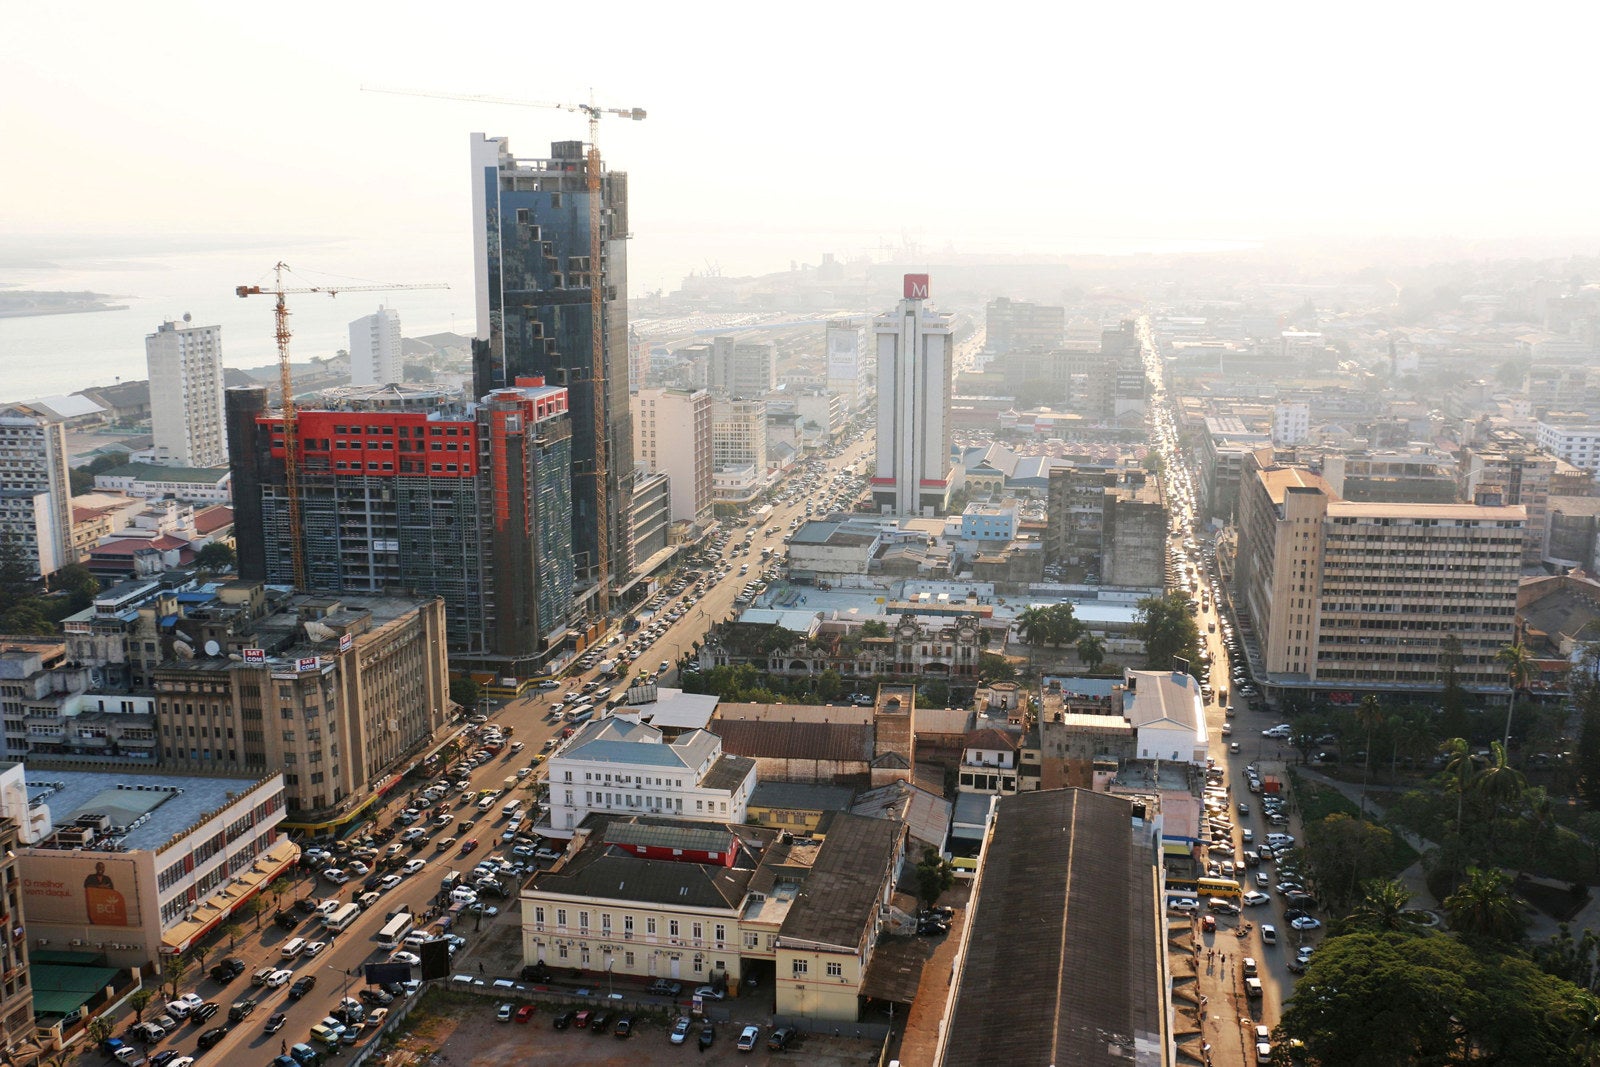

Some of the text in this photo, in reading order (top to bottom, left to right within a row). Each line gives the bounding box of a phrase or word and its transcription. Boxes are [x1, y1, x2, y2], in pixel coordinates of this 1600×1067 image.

[912, 282, 927, 297] M
[24, 879, 64, 888] O melhor
[97, 904, 115, 913] BCI
